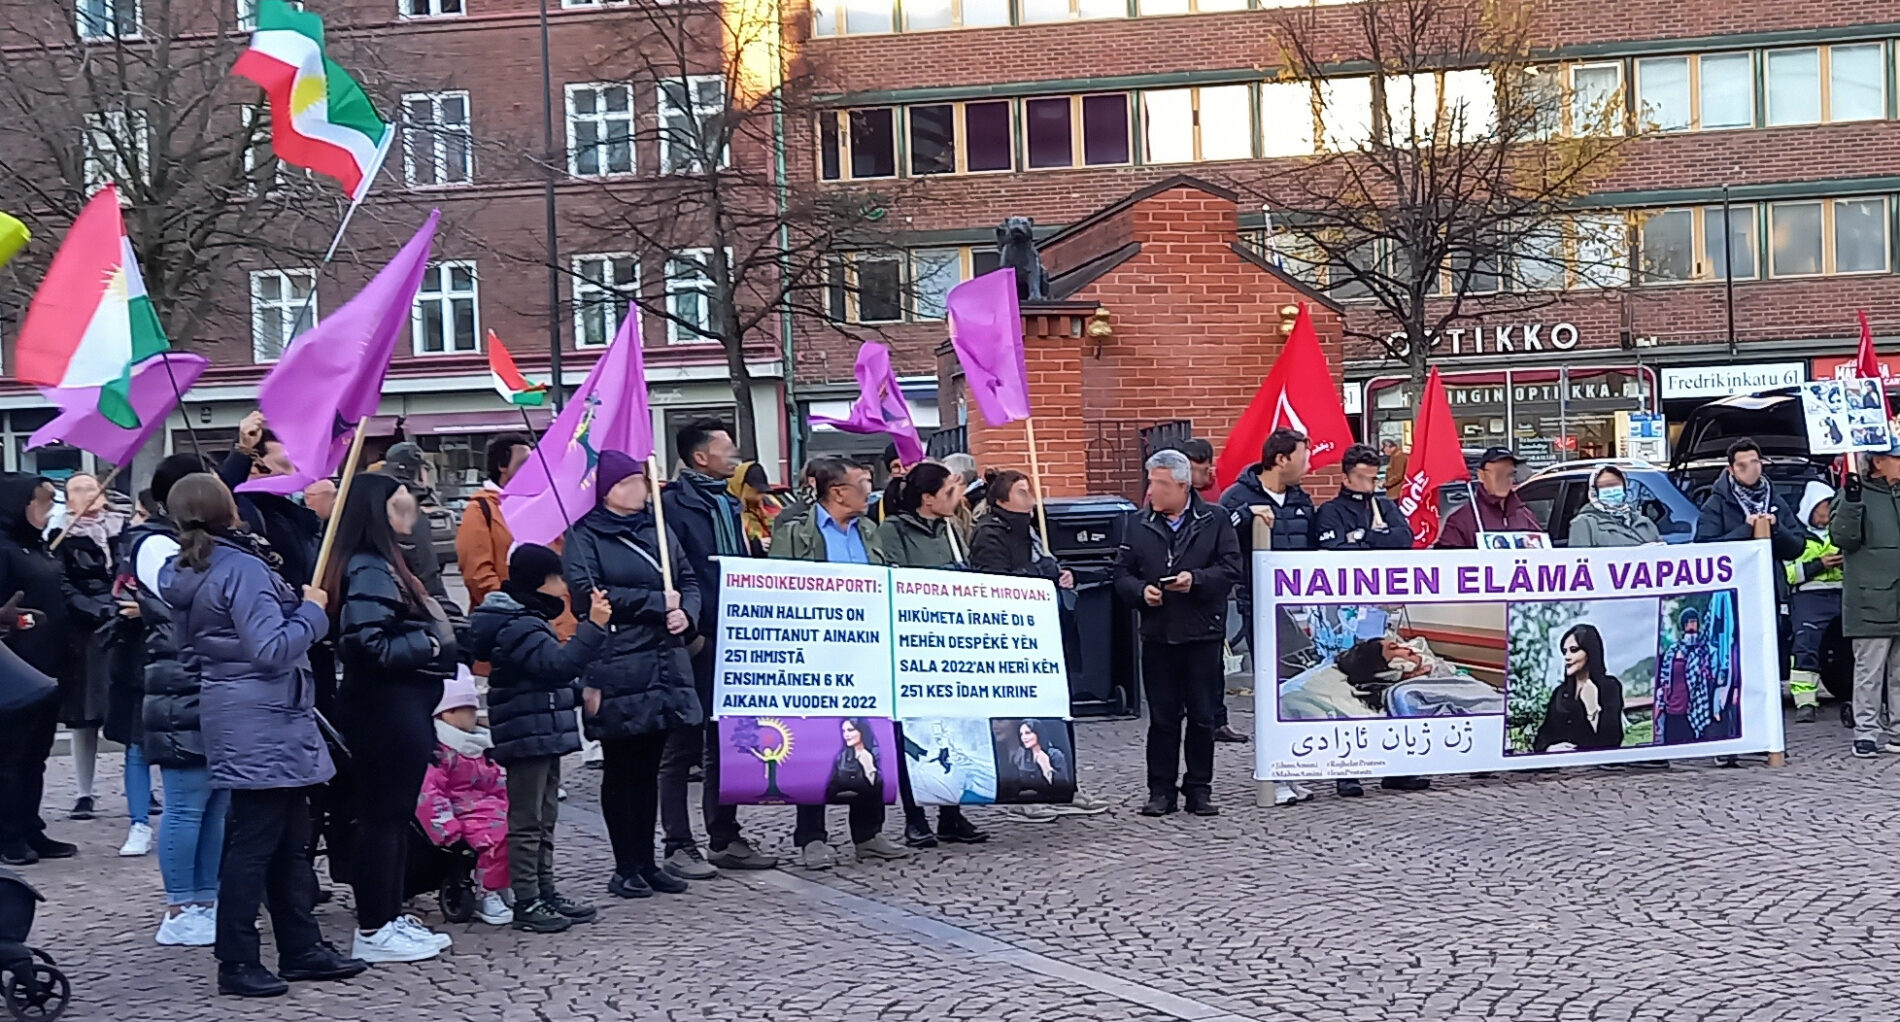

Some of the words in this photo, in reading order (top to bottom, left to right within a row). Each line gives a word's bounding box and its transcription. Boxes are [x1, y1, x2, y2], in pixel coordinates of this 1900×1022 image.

[1668, 372, 1778, 390] Fredrikinkatu
[1783, 371, 1799, 386] 61
[726, 573, 882, 594] IHMISOIKEUSRAPORTI:
[1274, 567, 1439, 597] NAINEN
[1457, 558, 1594, 594] ELÄMÄ
[1608, 555, 1733, 590] VAPAUS
[896, 581, 949, 597] RAPORA
[991, 586, 1051, 602] MIROVAN:
[726, 604, 773, 619] IRANIN
[776, 605, 843, 621] HALLITUS
[846, 608, 865, 622] ON
[1011, 613, 1024, 627] DI
[725, 626, 819, 642] TELOITTANUT
[823, 629, 880, 644] AINAKIN
[724, 649, 747, 663] 251
[750, 648, 805, 664] IHMISTÄ
[899, 659, 938, 673] SALA
[723, 669, 820, 686] ENSIMMÄINEN
[824, 673, 832, 686] 6
[835, 673, 855, 687] KK
[900, 684, 923, 698] 251
[926, 684, 953, 698] KES
[992, 685, 1038, 698] KIRINE
[722, 694, 779, 708] AIKANA
[782, 695, 839, 709] VUODEN
[842, 696, 877, 709] 2022
